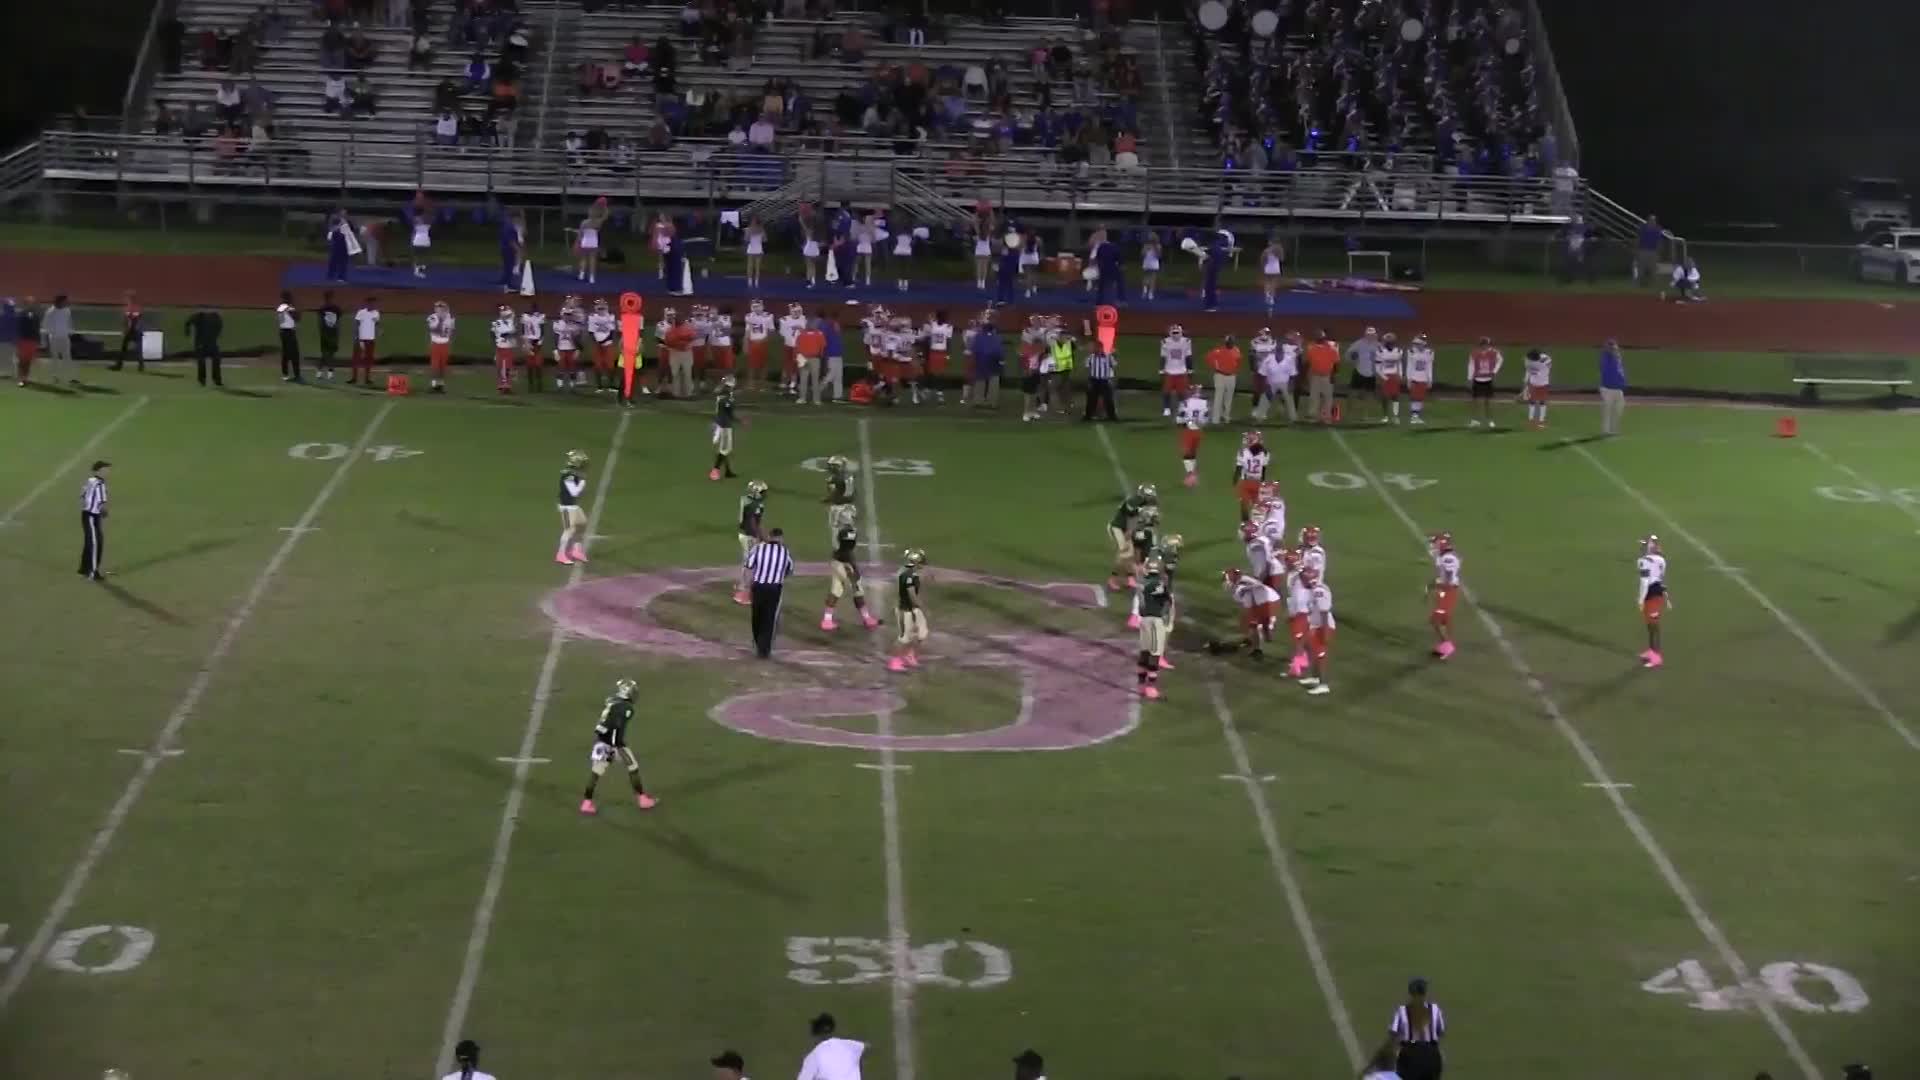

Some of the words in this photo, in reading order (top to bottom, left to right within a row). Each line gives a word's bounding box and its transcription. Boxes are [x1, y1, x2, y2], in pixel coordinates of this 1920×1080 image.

[1247, 459, 1260, 474] 12
[1306, 471, 1439, 491] 40
[540, 560, 1141, 751] S
[787, 936, 1012, 987] 50
[1640, 959, 1869, 1012] 40
